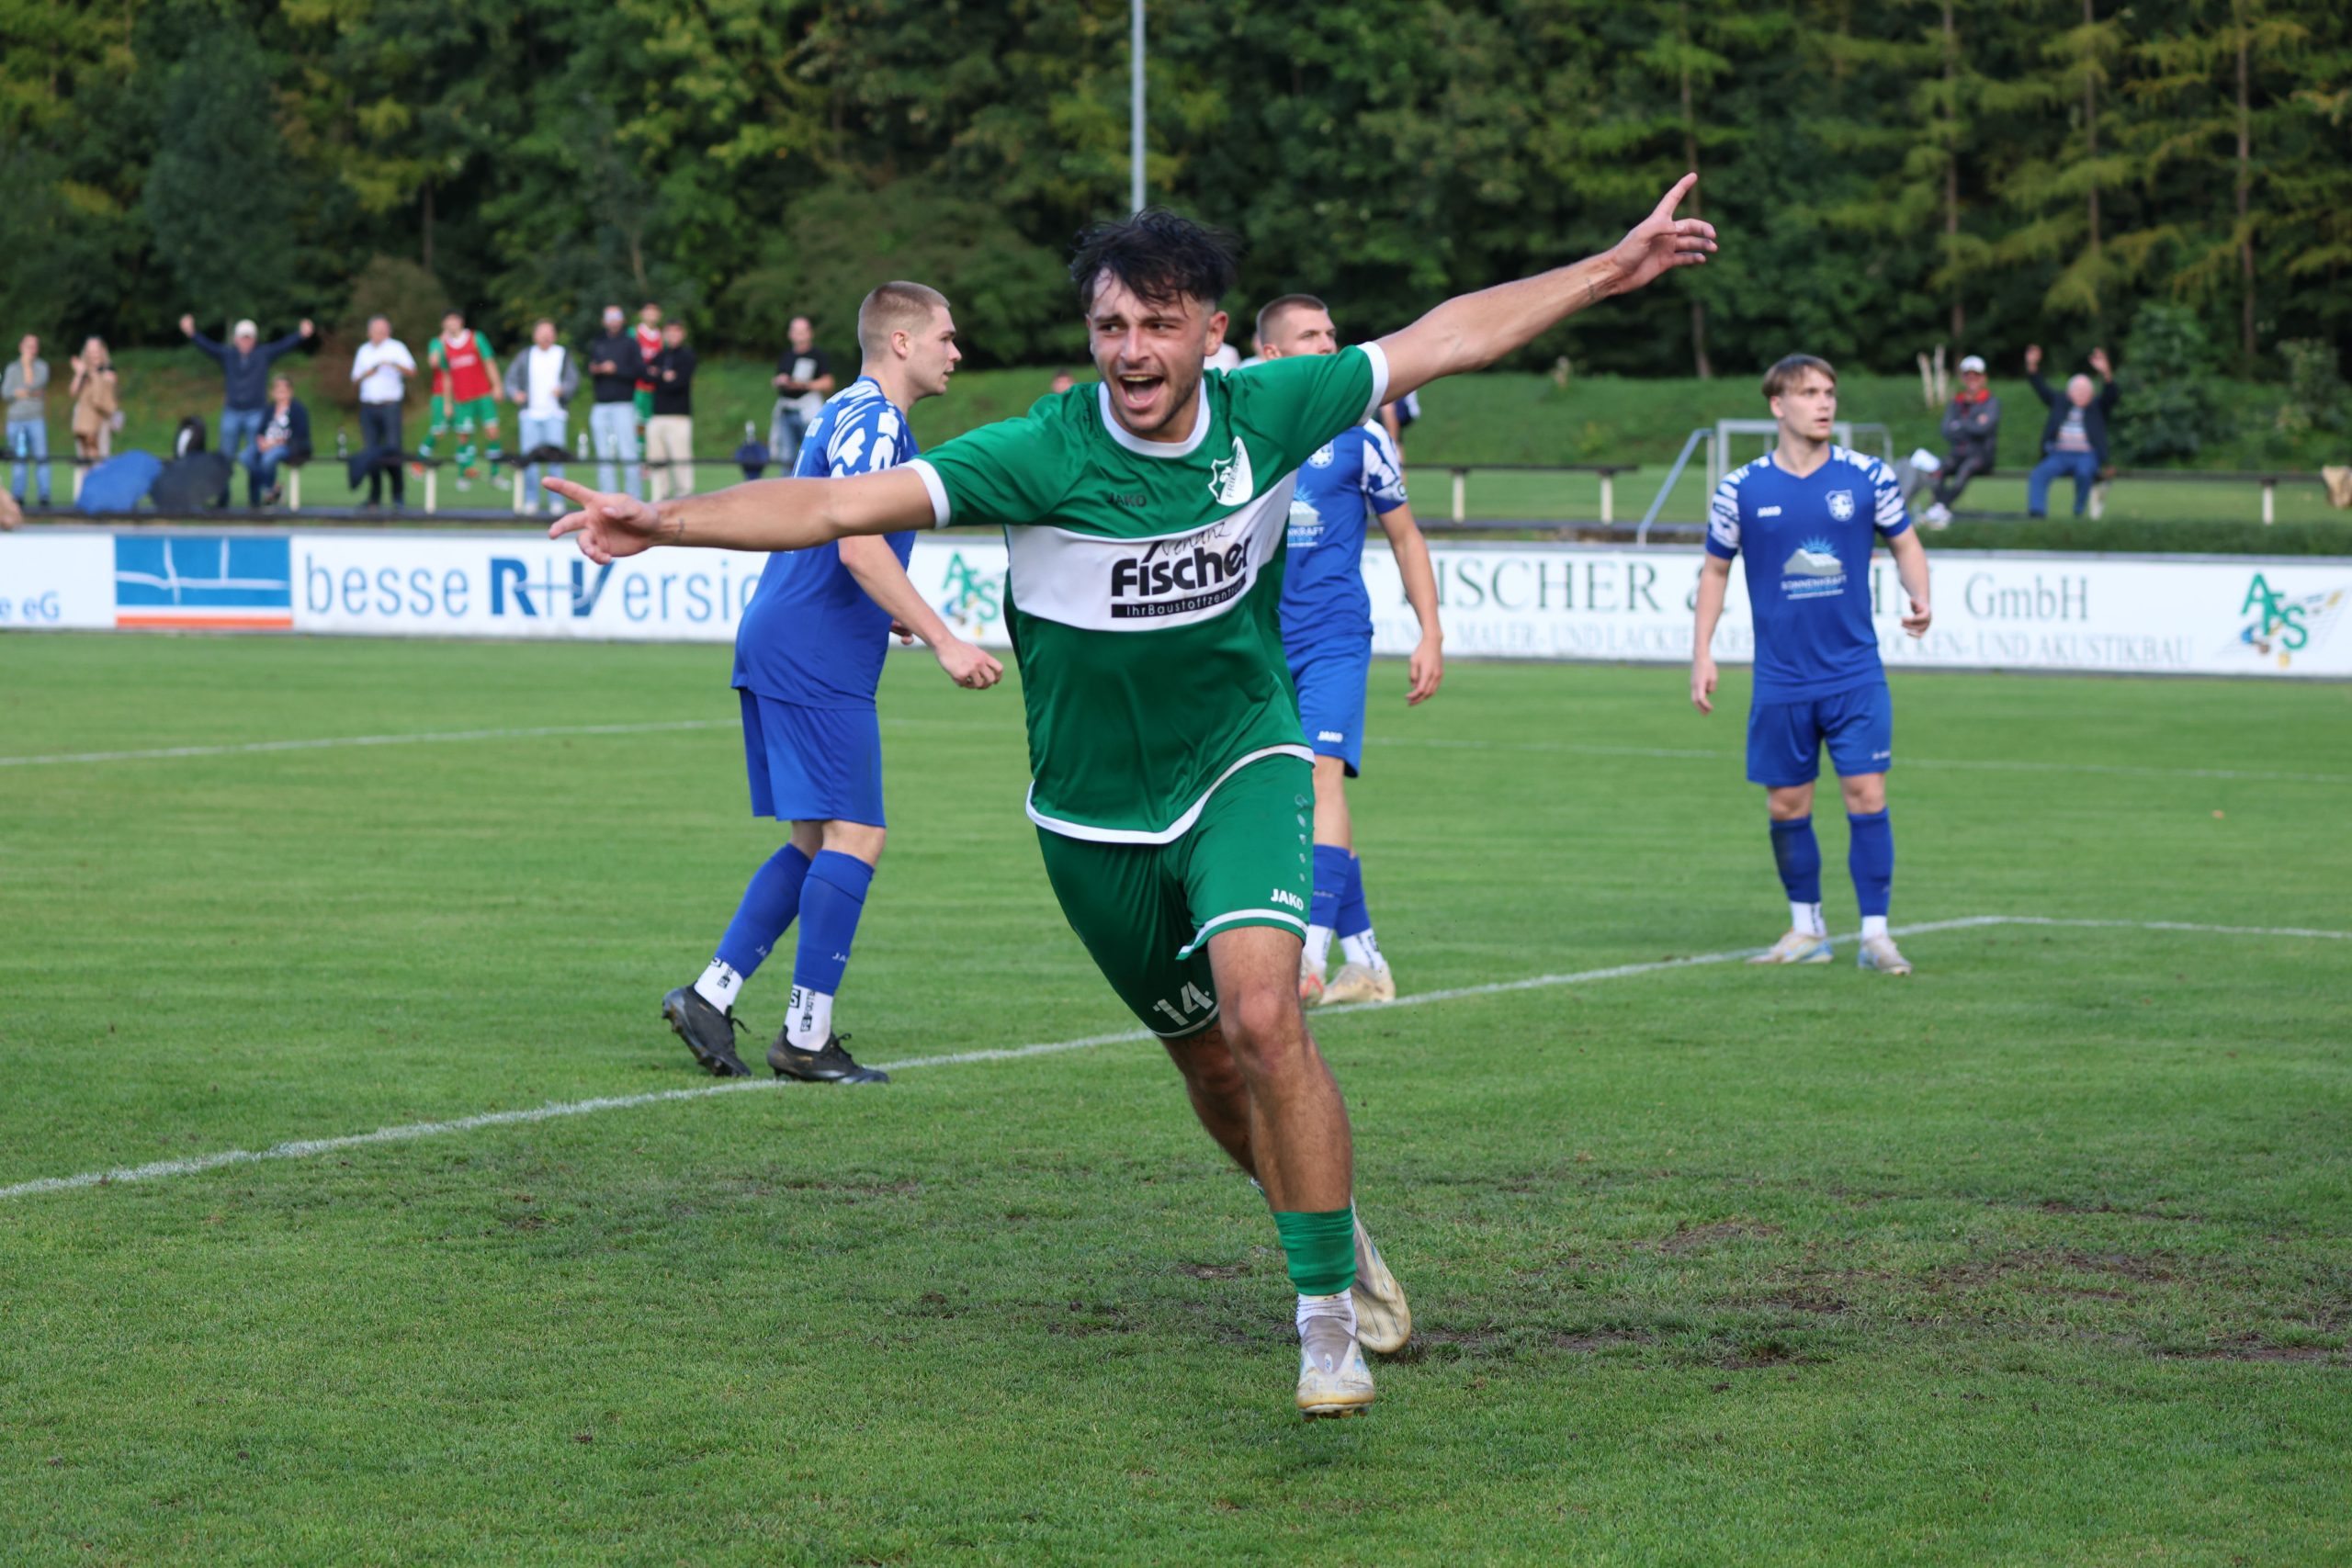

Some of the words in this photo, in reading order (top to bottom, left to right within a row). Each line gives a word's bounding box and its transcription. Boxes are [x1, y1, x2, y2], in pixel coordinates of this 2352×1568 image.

[1107, 492, 1148, 508] JAKO
[1111, 534, 1253, 597] Fischer
[22, 589, 61, 622] eG
[1401, 557, 1662, 611] ISCHER
[1964, 570, 2089, 621] GmbH
[1271, 888, 1304, 911] JAKO
[1152, 980, 1215, 1027] 14
